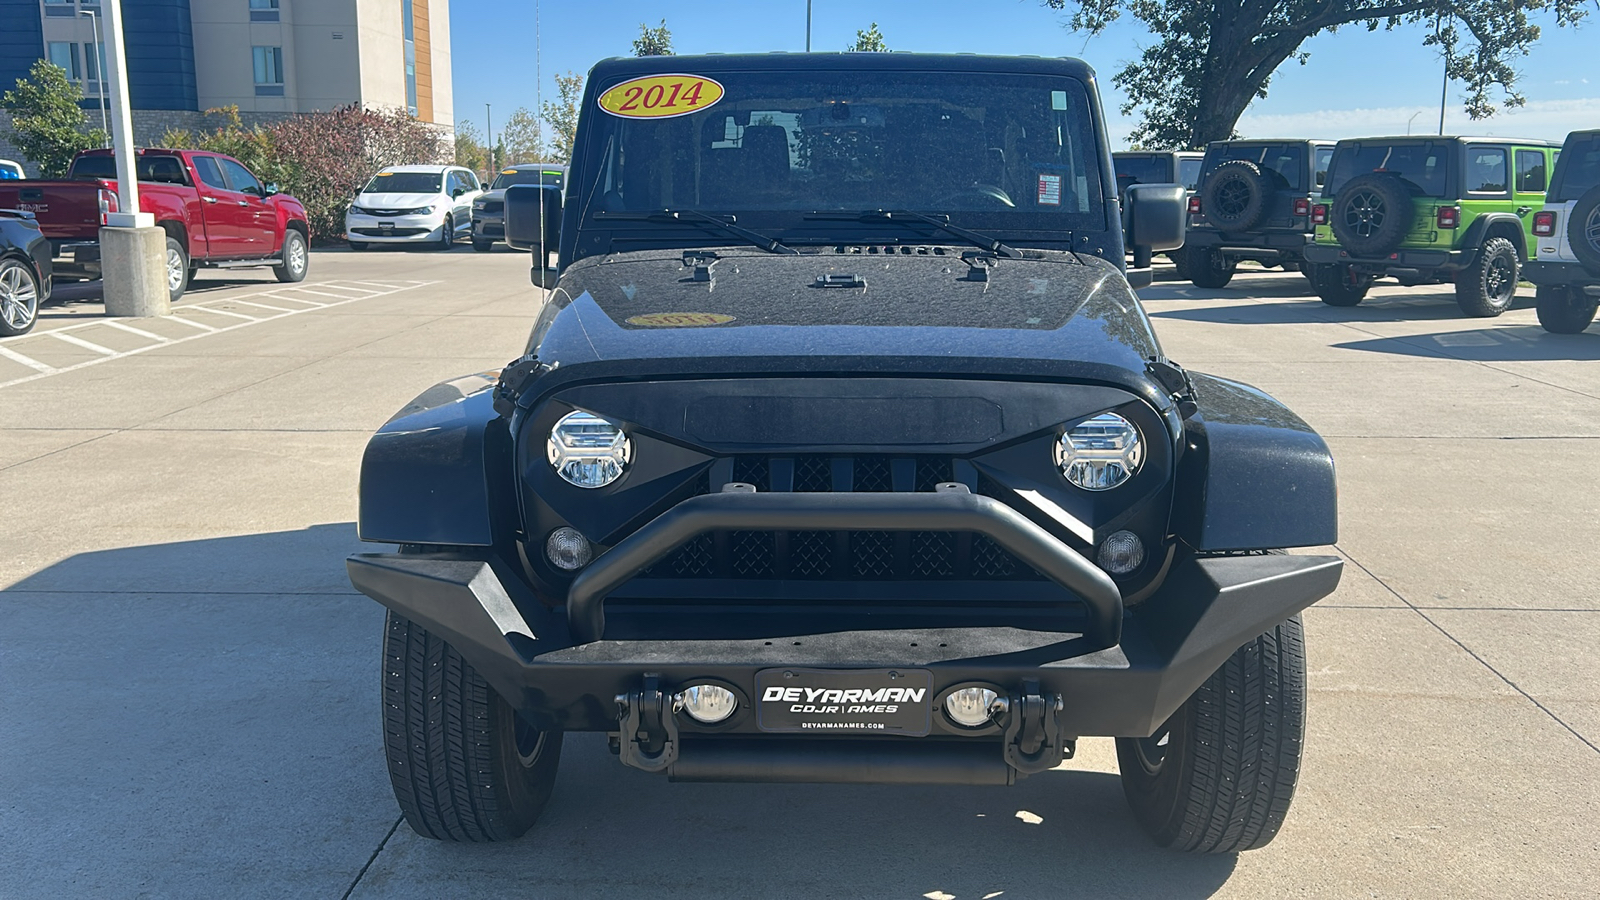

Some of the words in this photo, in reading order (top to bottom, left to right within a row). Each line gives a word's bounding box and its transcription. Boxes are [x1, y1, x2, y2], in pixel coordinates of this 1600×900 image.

[619, 81, 704, 111] 2014
[16, 204, 48, 213] GMC
[762, 686, 926, 703] DEYARMAN
[789, 704, 839, 713] CDJR
[847, 705, 899, 713] AMES
